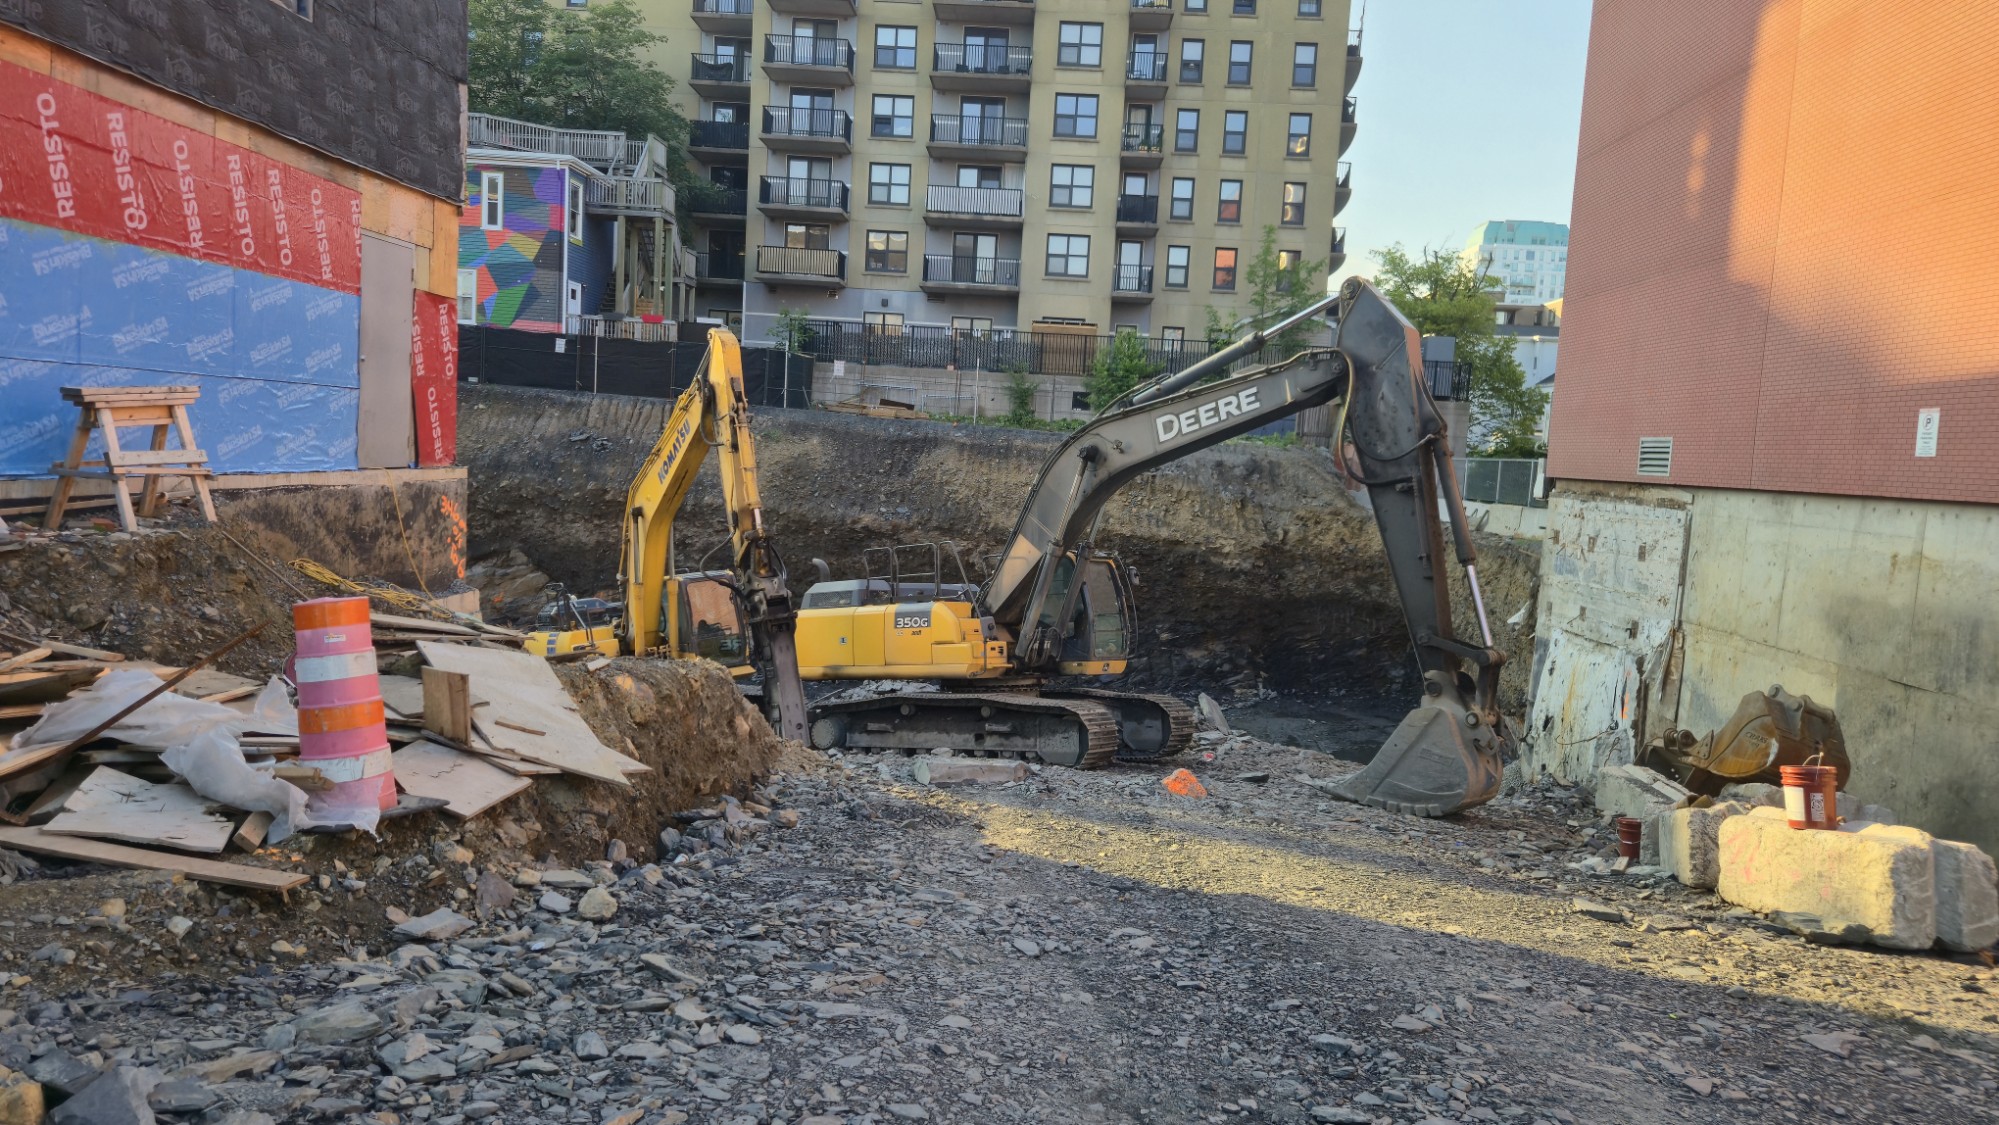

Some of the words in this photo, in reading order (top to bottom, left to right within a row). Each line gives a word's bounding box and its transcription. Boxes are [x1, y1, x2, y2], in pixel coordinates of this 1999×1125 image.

[37, 93, 75, 218] RESISTO
[107, 113, 138, 229] RESISTO
[174, 140, 204, 248] RESISTO
[227, 155, 254, 256] RESISTO
[267, 169, 292, 266] RESISTO
[311, 189, 332, 279] RESISTO
[439, 303, 454, 376] RESISTO
[428, 387, 443, 460] RESISTO
[657, 418, 690, 485] KOMATSU
[1155, 386, 1260, 443] DEERE
[896, 617, 928, 628] 350G
